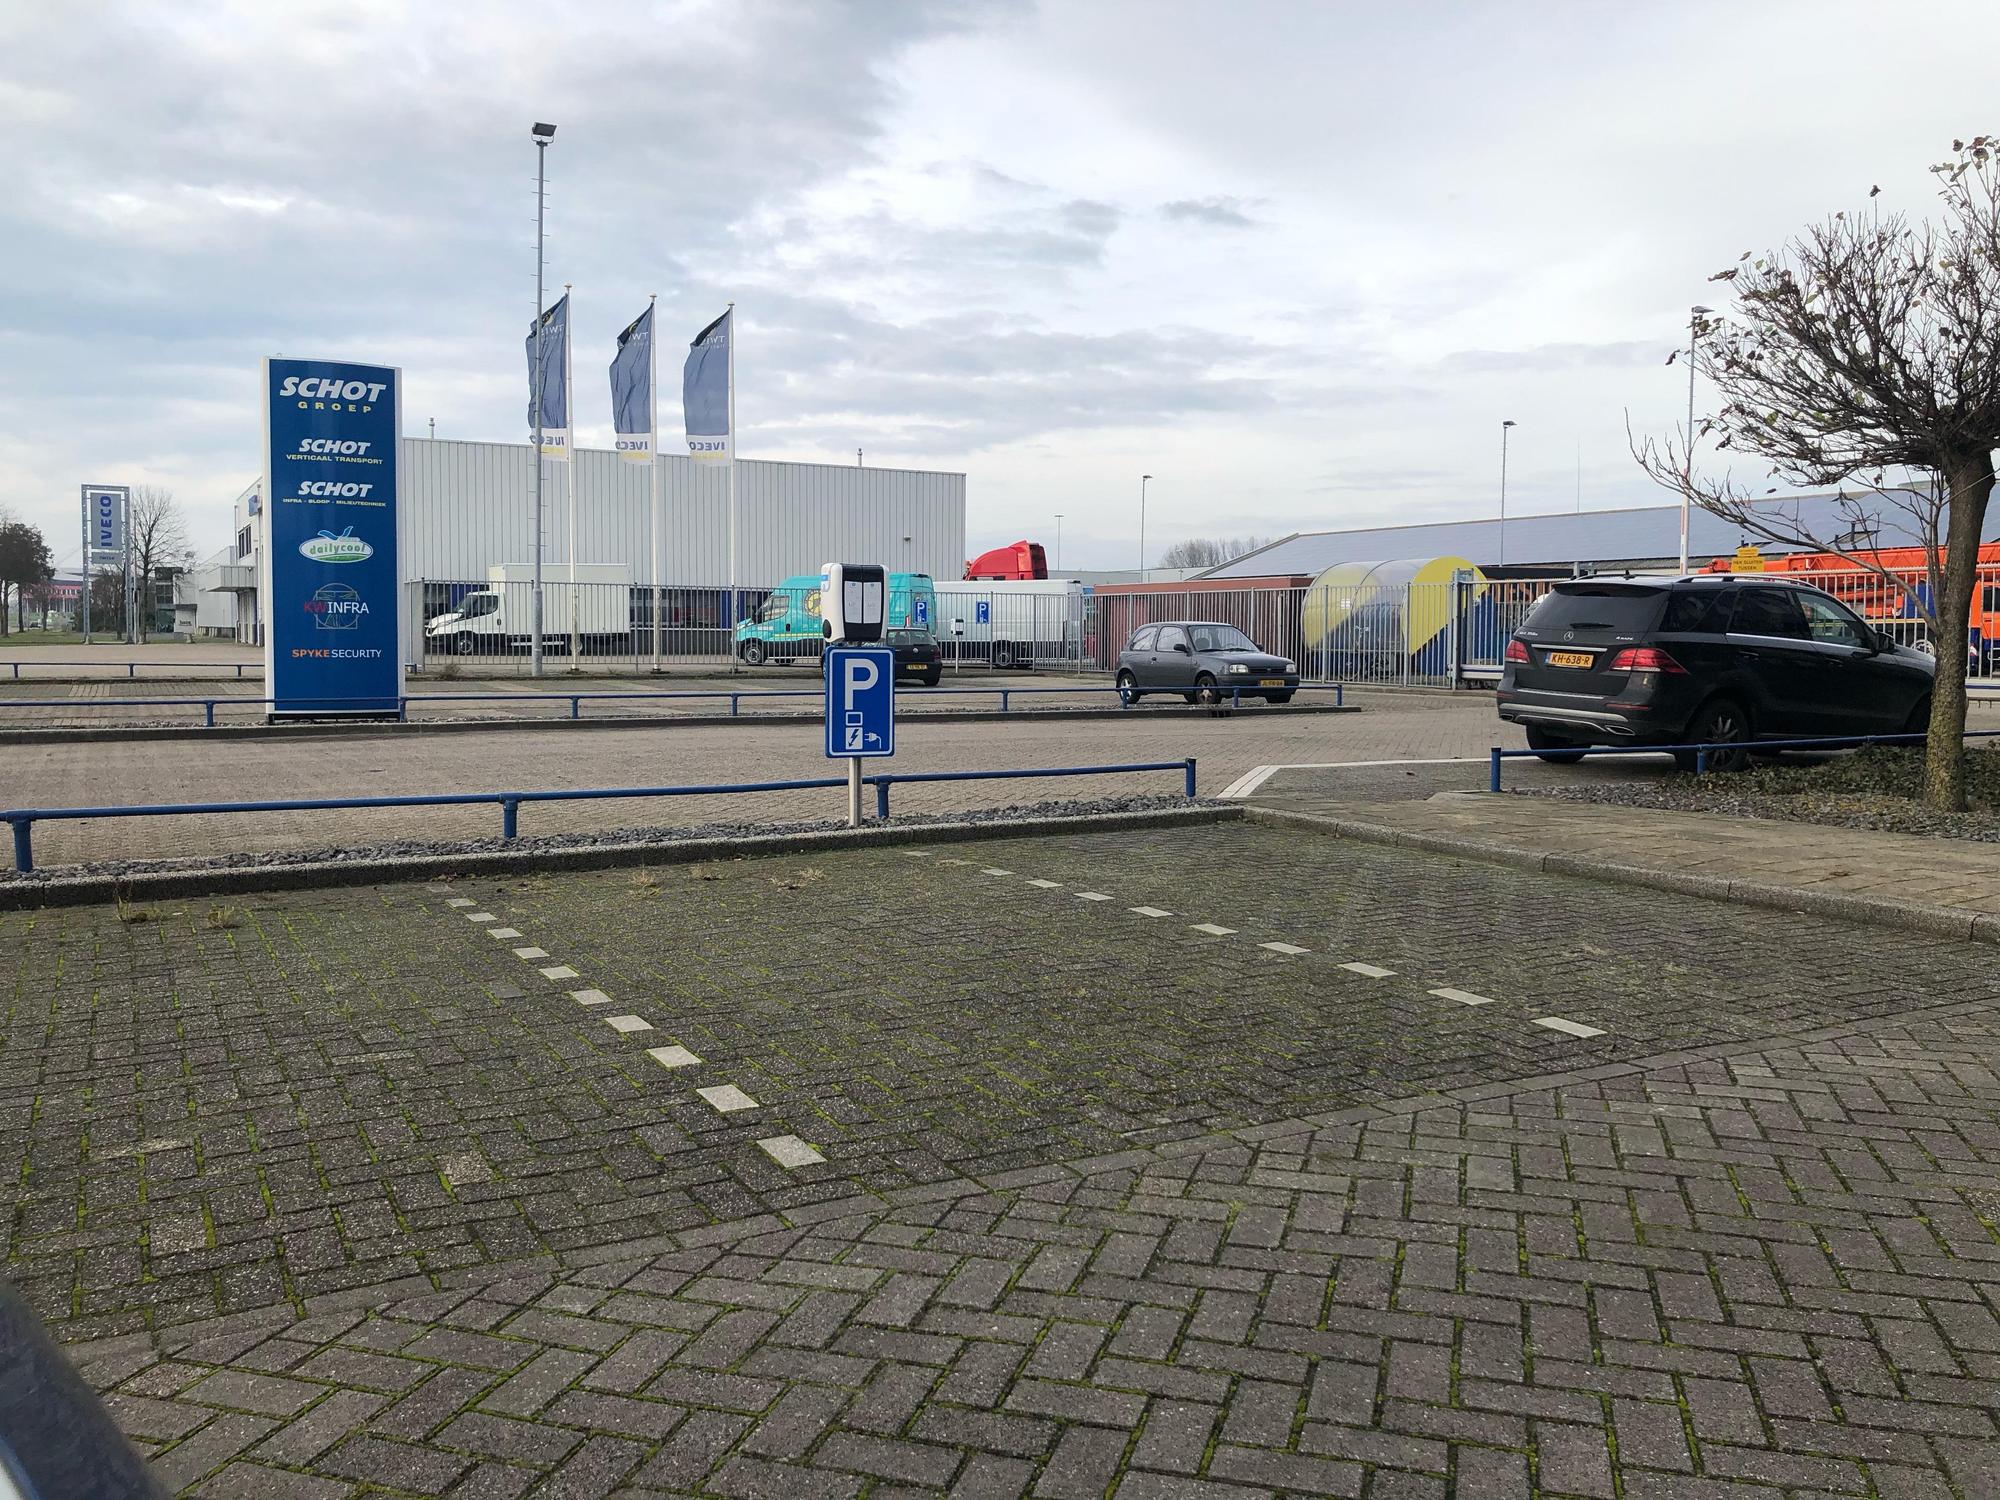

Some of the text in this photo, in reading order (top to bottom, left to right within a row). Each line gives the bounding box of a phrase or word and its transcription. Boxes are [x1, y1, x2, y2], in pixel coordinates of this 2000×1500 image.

[280, 376, 387, 402] SCHOT
[298, 401, 372, 413] GROEP
[299, 438, 371, 455] SCHOT
[286, 454, 383, 465] VERTICAAL TRANSPORT
[298, 481, 373, 497] SCHOT
[100, 495, 112, 547] IVECO
[310, 543, 366, 554] dailycool
[979, 603, 987, 614] P
[292, 649, 382, 658] SPYKE SECURITY
[1551, 653, 1590, 665] KH-638-R
[844, 658, 878, 710] P
